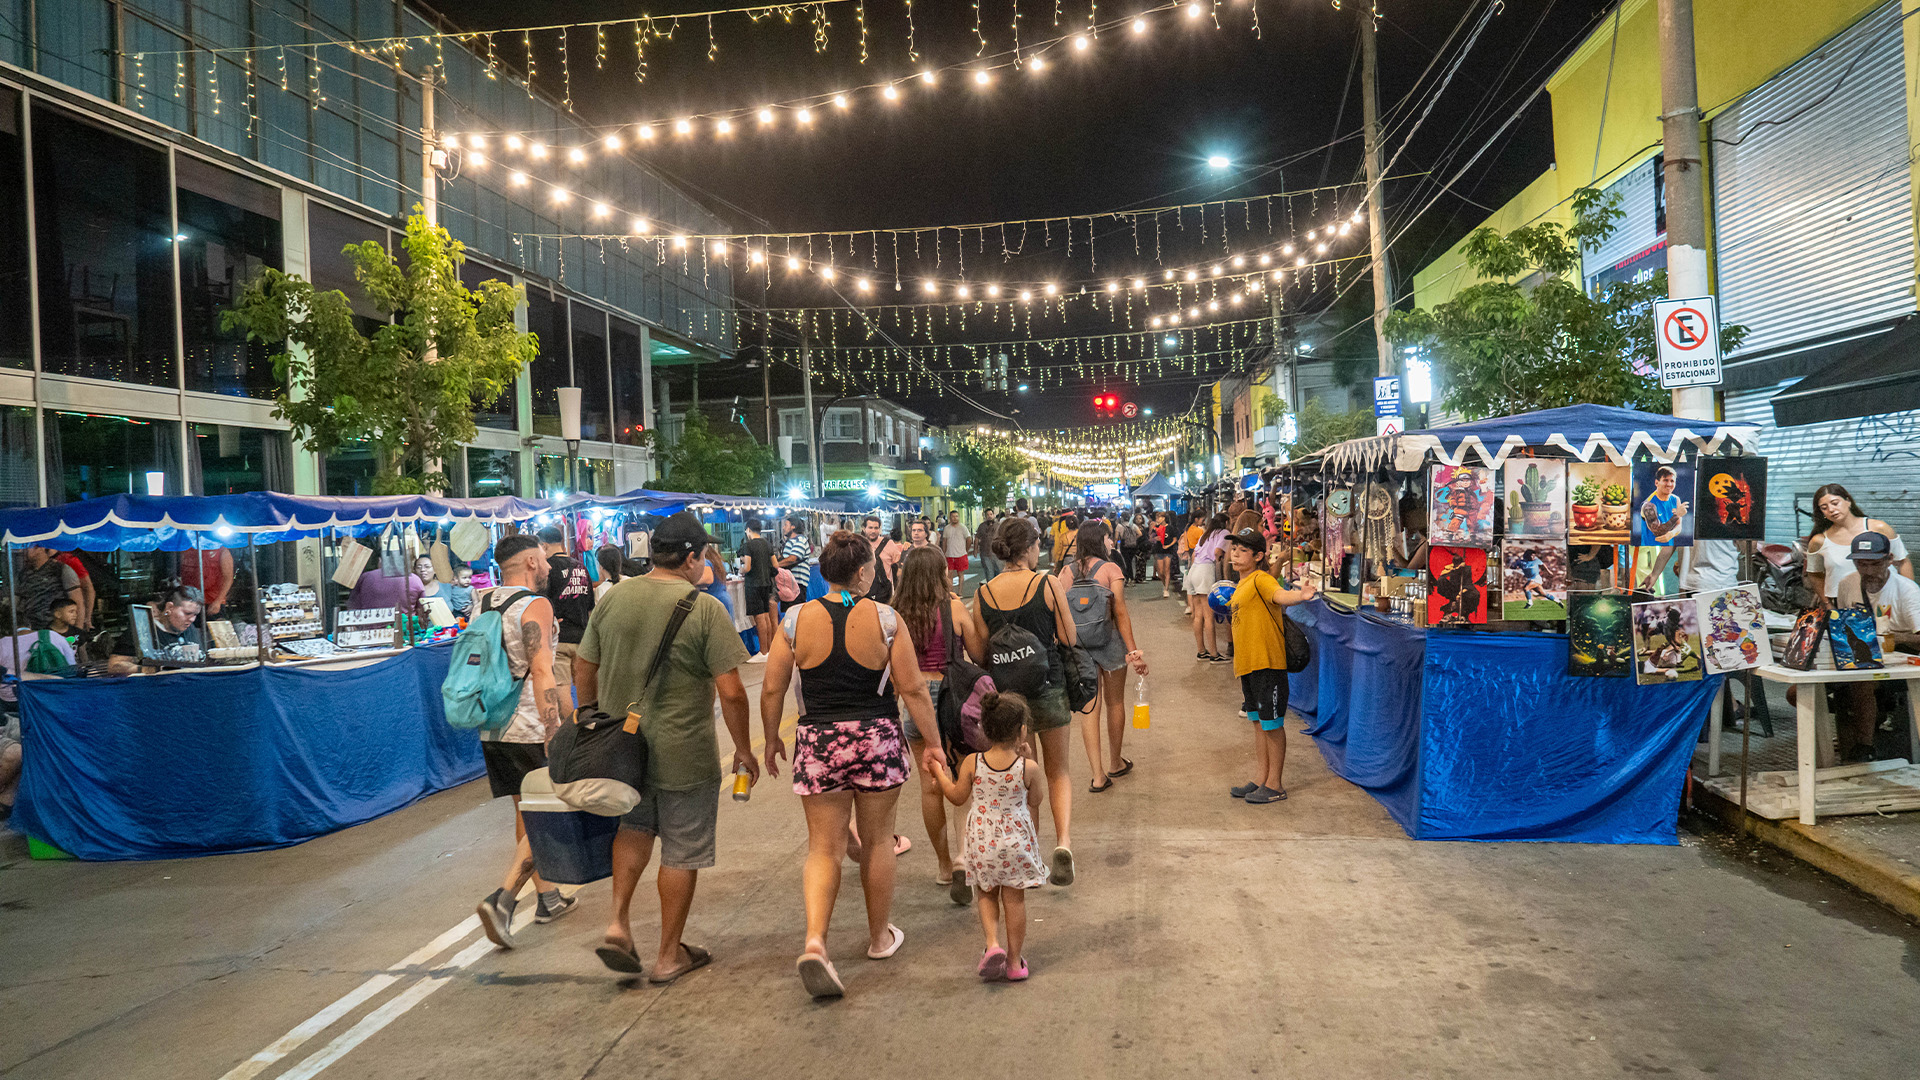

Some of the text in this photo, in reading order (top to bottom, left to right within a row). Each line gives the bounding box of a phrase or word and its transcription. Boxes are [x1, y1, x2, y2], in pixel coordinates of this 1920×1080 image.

[1664, 358, 1715, 370] PROHIBIDO
[1665, 368, 1716, 380] ESTACIONAR
[992, 645, 1036, 665] SMATA
